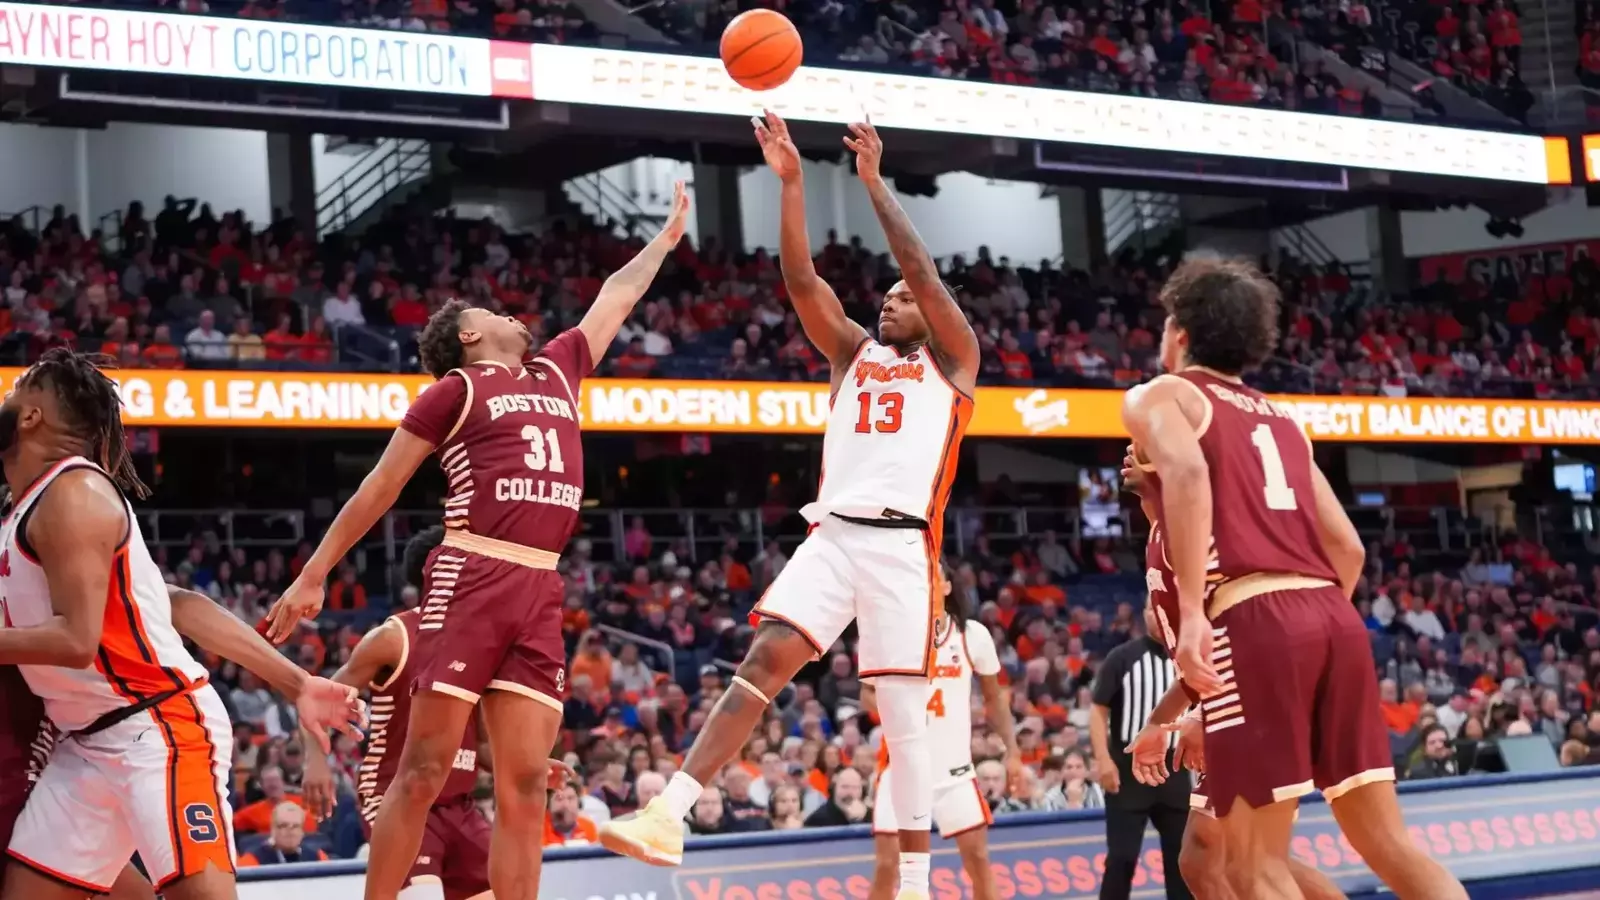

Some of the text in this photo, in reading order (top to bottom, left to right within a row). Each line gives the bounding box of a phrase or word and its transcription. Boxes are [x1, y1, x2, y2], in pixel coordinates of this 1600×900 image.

[127, 19, 220, 69] HOYT
[233, 27, 467, 87] CORPORATION
[163, 379, 196, 418] &
[203, 379, 409, 420] LEARNING
[486, 393, 575, 422] BOSTON
[590, 386, 751, 424] MODERN
[854, 391, 905, 434] 13
[1368, 403, 1488, 437] BALANCE
[1491, 405, 1527, 438] OF
[521, 424, 565, 474] 31
[1250, 422, 1298, 511] 1
[495, 477, 582, 513] COLLEGE
